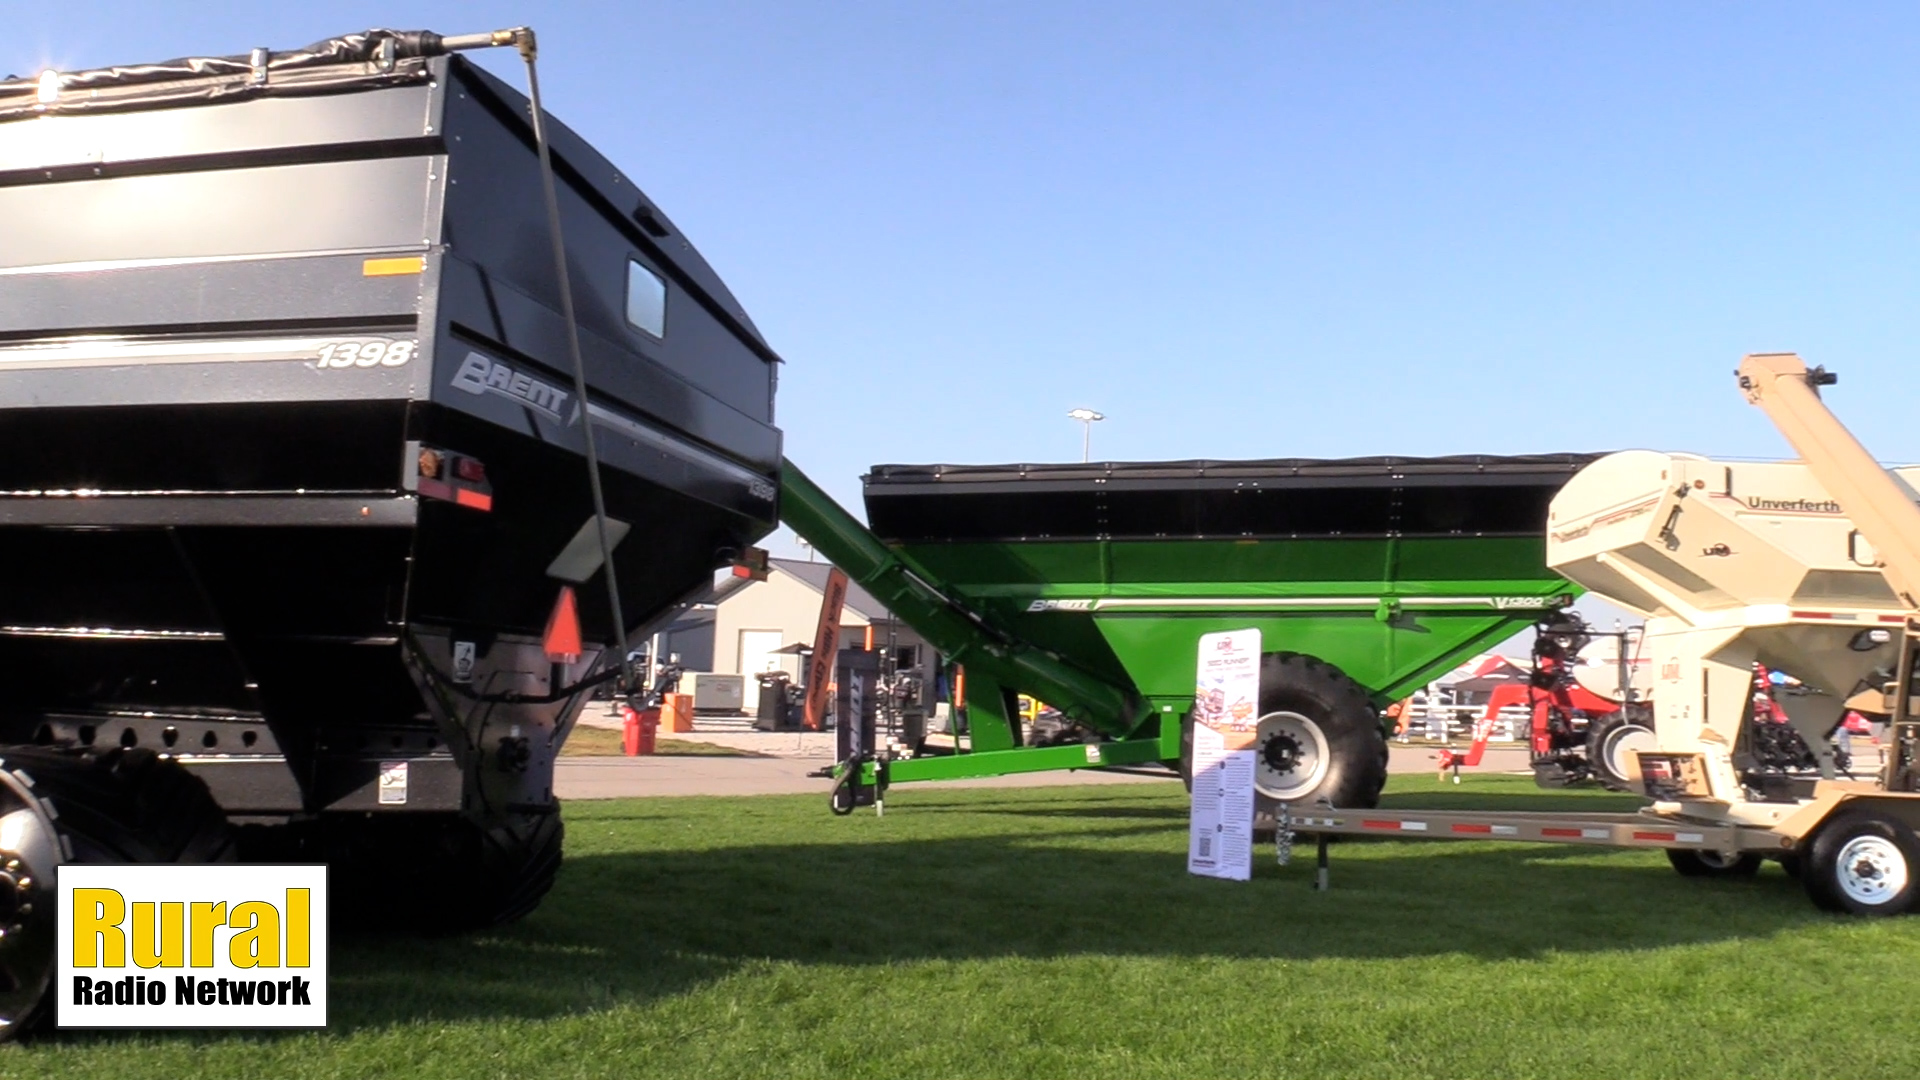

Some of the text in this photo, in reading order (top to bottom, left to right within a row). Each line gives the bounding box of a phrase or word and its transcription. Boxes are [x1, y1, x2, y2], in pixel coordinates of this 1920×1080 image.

[316, 340, 414, 369] 1398
[450, 351, 568, 414] BRENT
[1748, 496, 1841, 513] Unverferth
[1026, 599, 1093, 612] BRENT
